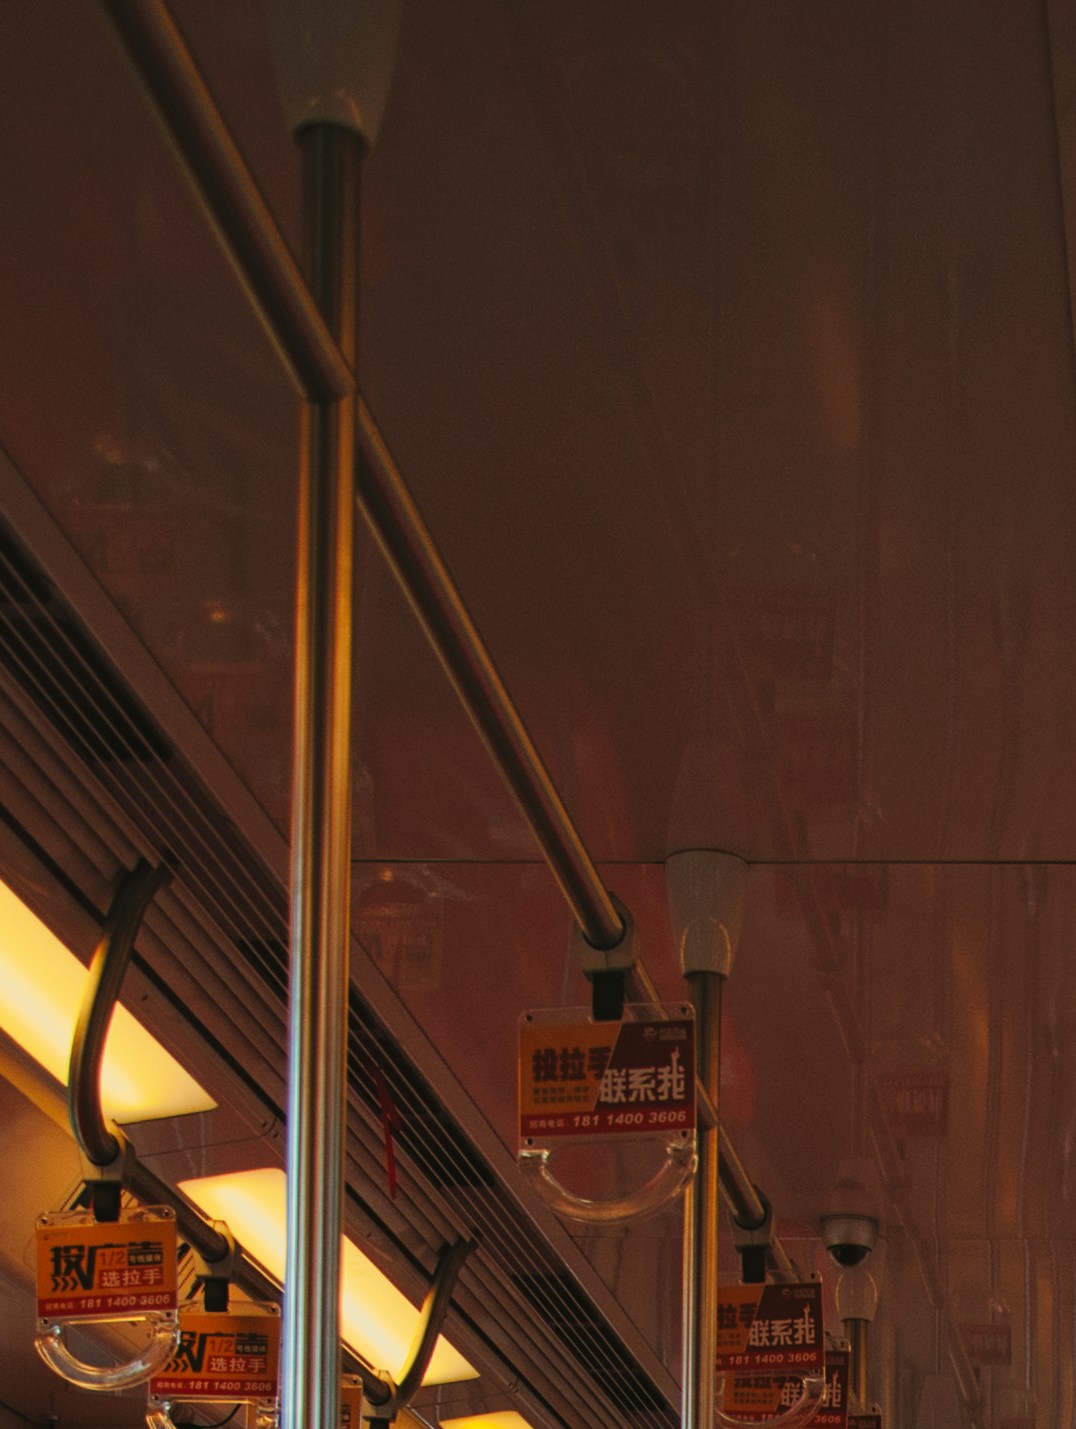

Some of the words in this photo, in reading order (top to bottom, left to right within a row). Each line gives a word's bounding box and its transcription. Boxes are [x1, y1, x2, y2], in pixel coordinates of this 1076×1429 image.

[599, 1045, 686, 1103] 联系我
[573, 1115, 600, 1127] 181
[607, 1113, 643, 1125] 1400
[648, 1111, 686, 1123] 3606
[102, 1269, 161, 1287] 选拉手
[81, 1299, 101, 1308] 181
[107, 1297, 136, 1307] 1400
[140, 1295, 170, 1305] 3606
[717, 1303, 758, 1329] 拉手
[749, 1302, 815, 1347] 联系我
[210, 1357, 266, 1373] 选拉手
[729, 1356, 749, 1366] 181
[755, 1354, 784, 1365] 1400
[788, 1352, 817, 1362] 3606
[189, 1381, 209, 1390] 181
[213, 1382, 241, 1391] 1400
[244, 1383, 272, 1391] 3606
[815, 1415, 841, 1424] 3606
